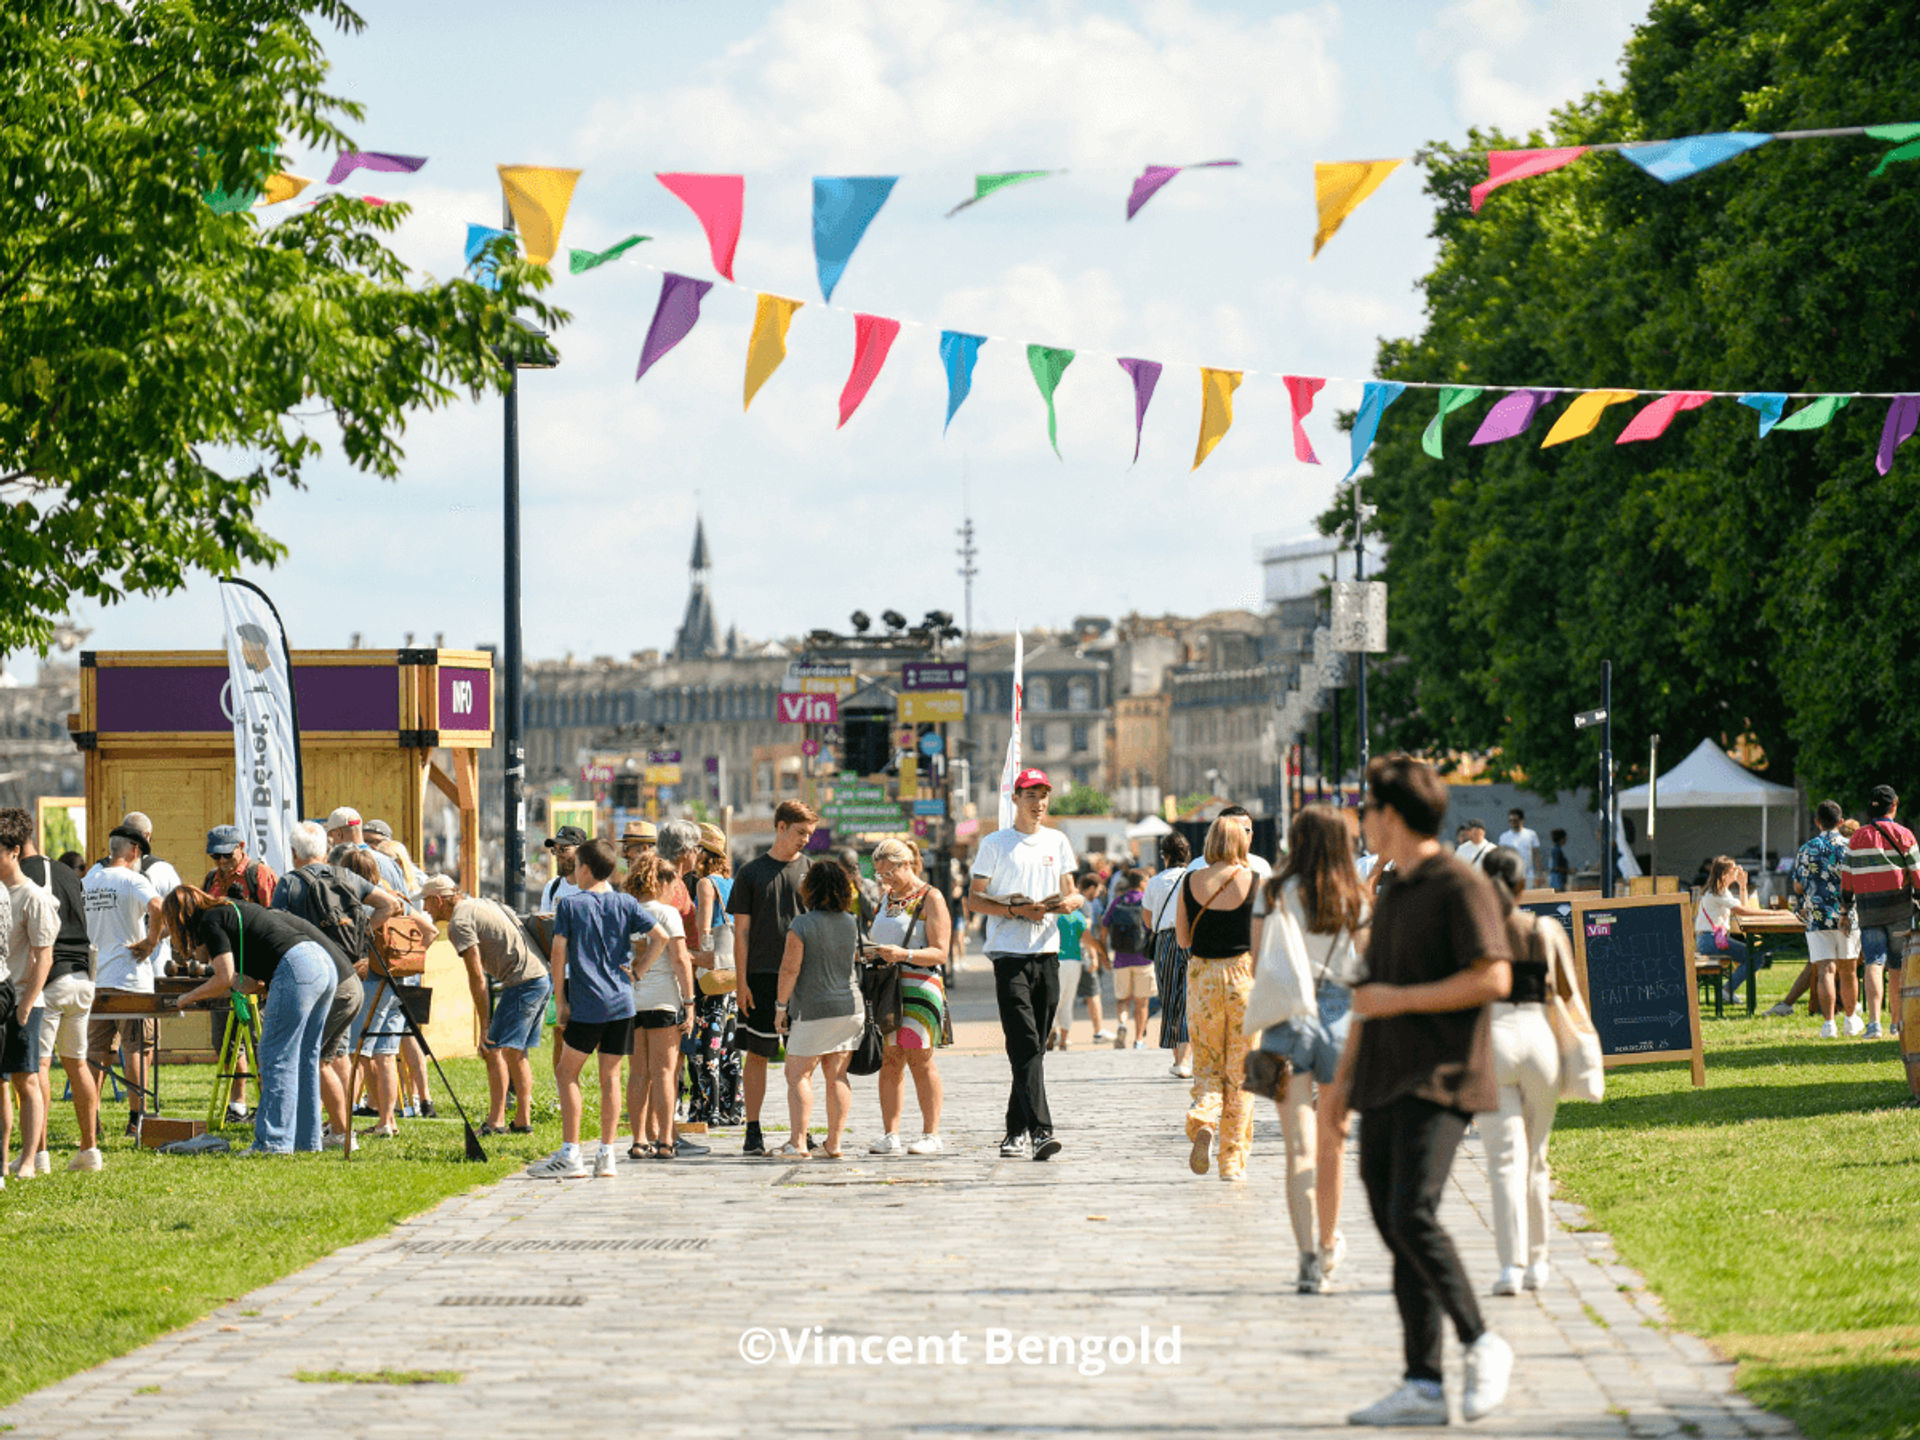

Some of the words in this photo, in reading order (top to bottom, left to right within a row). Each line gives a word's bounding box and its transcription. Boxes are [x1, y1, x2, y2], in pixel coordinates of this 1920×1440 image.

[452, 680, 473, 715] INFO
[783, 695, 831, 720] Vin
[1588, 925, 1608, 936] Vin
